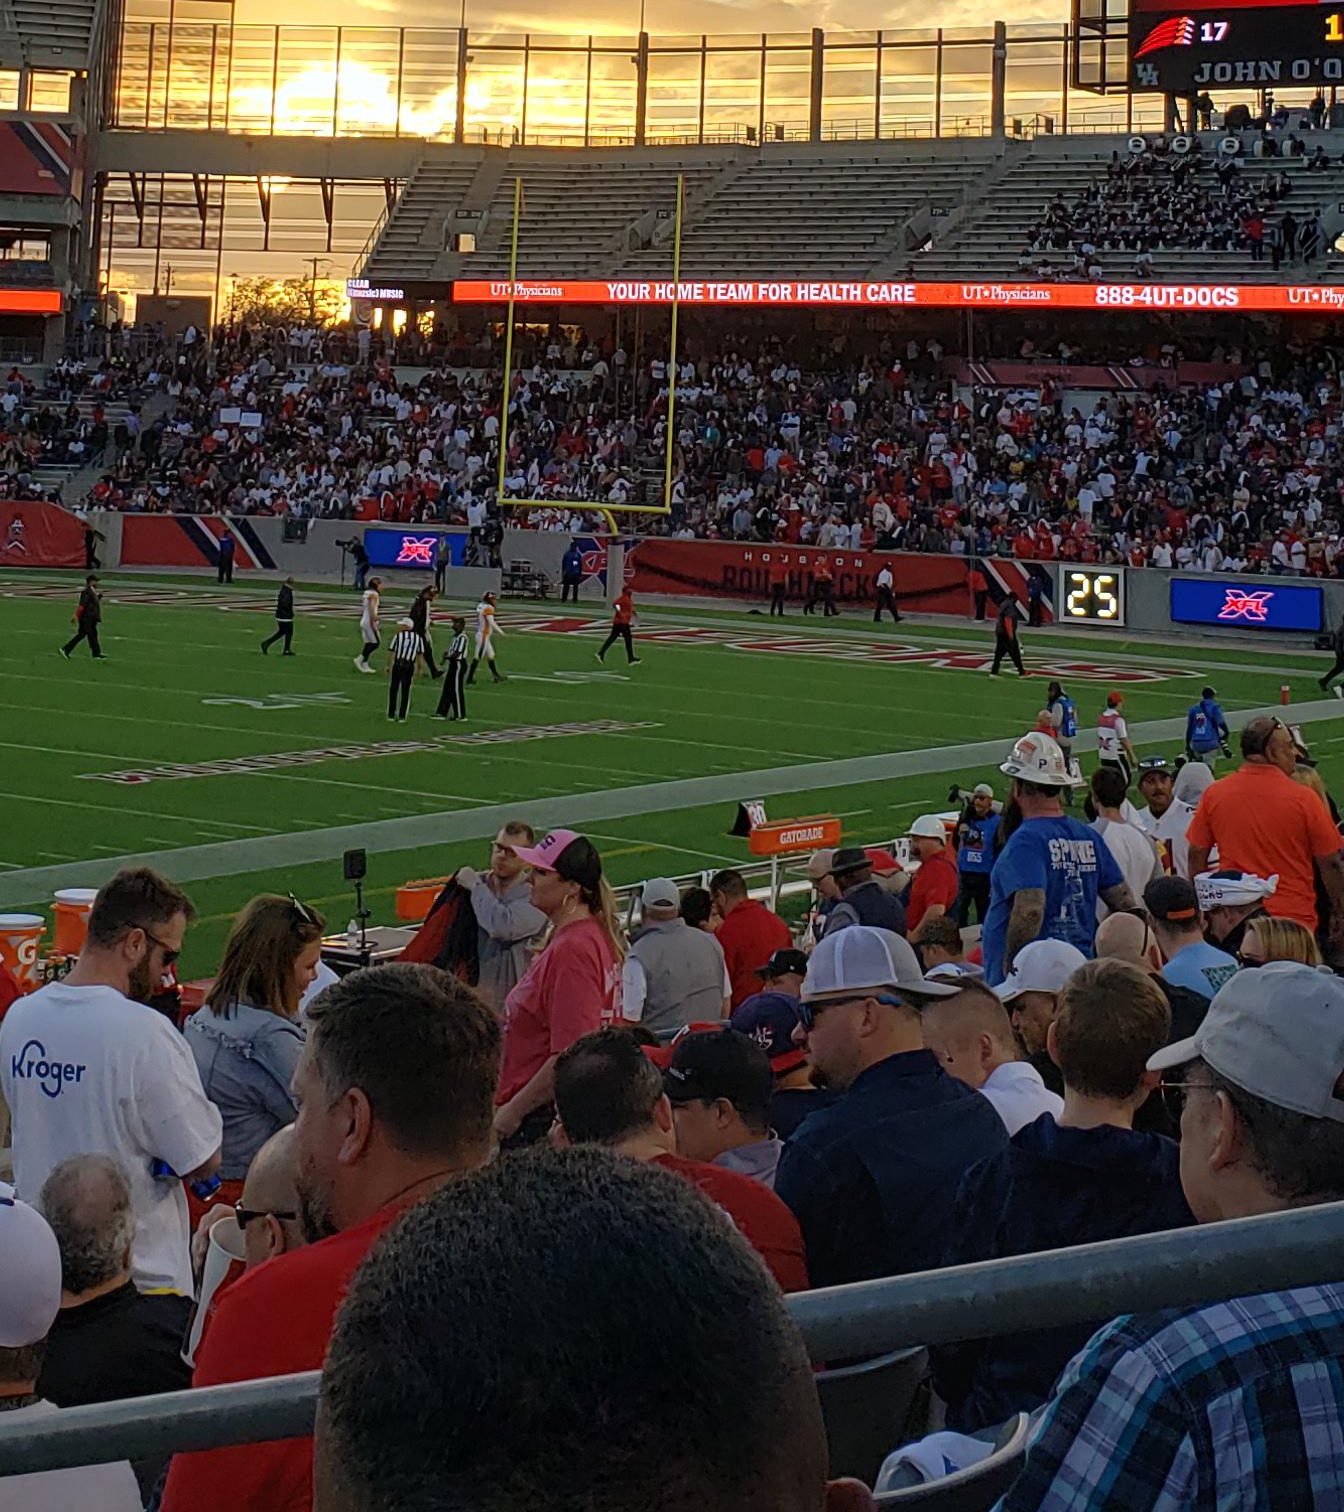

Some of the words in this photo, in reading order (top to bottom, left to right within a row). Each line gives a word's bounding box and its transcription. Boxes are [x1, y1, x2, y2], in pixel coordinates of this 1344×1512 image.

[1200, 22, 1228, 41] 17
[1194, 61, 1281, 83] JOHN
[607, 282, 651, 300] YOUR
[707, 282, 753, 301] TEAM
[758, 282, 792, 301] FOR
[796, 282, 862, 301] HEALTH
[866, 284, 915, 302] CARE
[1095, 285, 1239, 306] 888-4UT-DOCS
[1067, 573, 1117, 617] 25
[780, 826, 824, 845] GATORADE
[17, 939, 38, 965] G
[12, 1040, 86, 1098] Kroger
